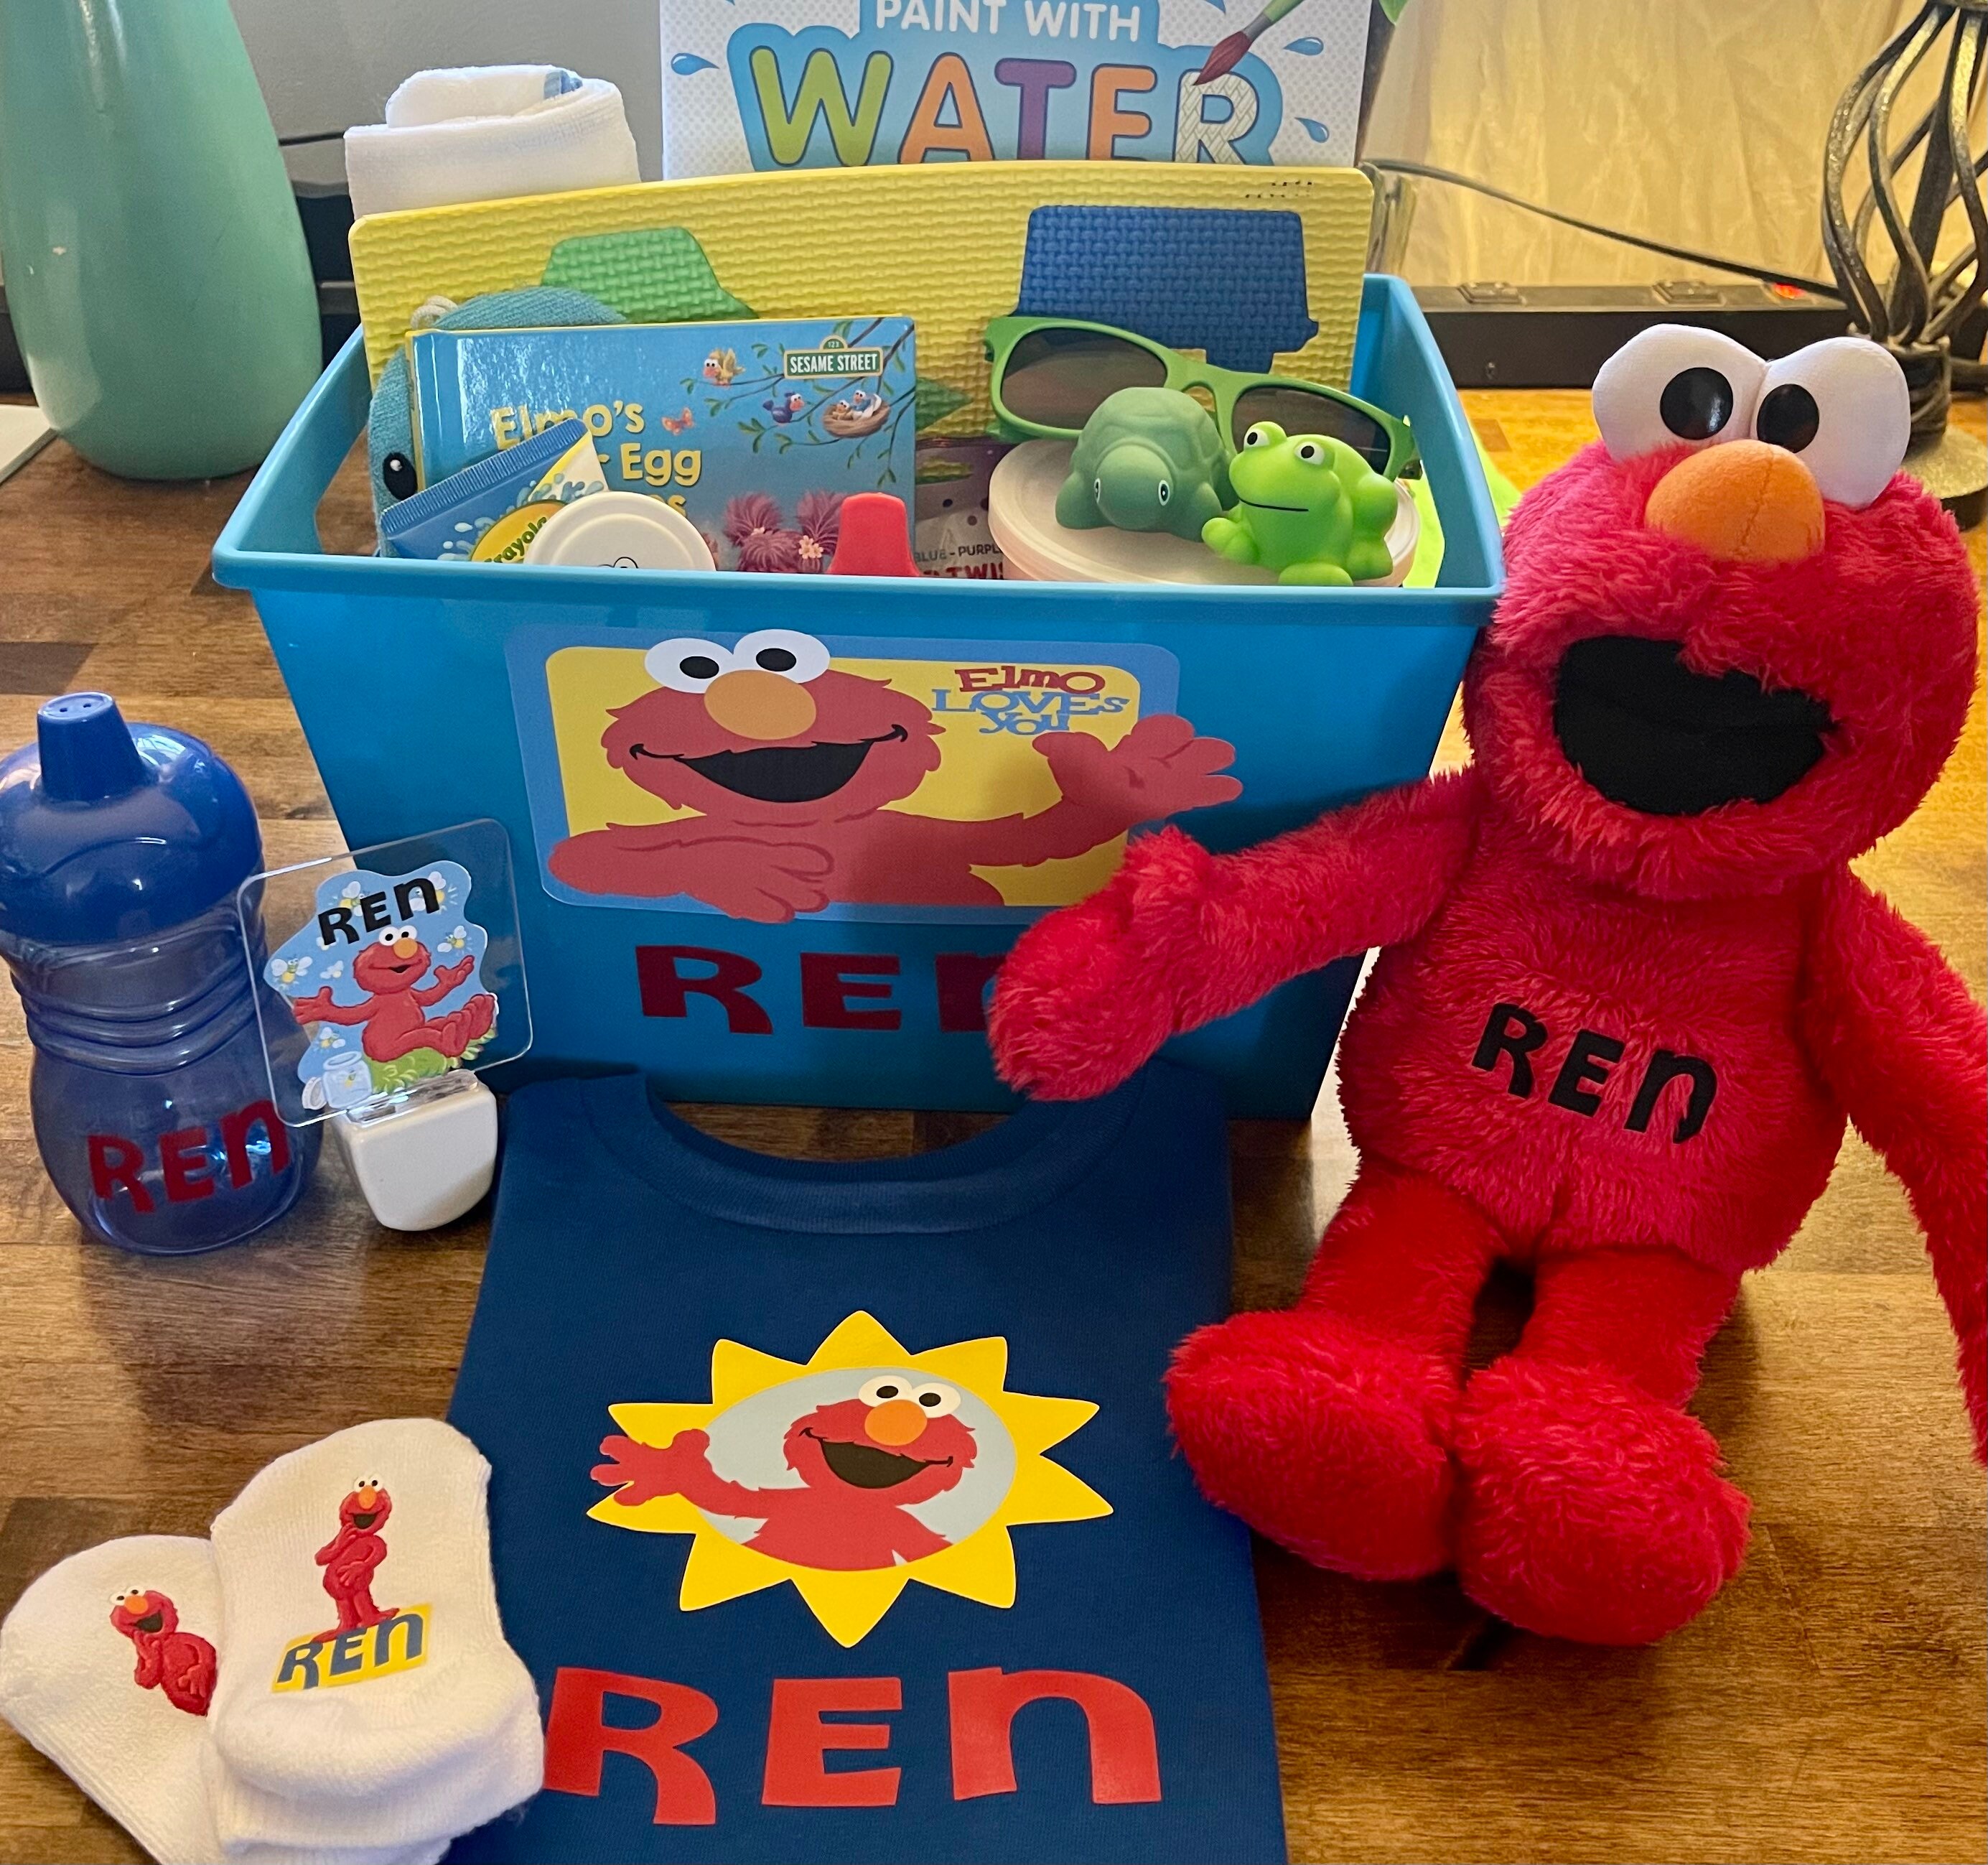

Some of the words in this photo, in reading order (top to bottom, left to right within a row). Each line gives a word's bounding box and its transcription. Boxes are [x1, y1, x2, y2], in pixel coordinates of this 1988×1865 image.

[875, 0, 1007, 34] PAINT
[1024, 1, 1141, 42] WITH
[749, 45, 1261, 167] WATER
[790, 355, 834, 373] SESAME
[837, 353, 877, 371] STREET
[620, 442, 702, 486] Egg
[958, 544, 1003, 557] PURPL
[954, 665, 1106, 694] Elmo
